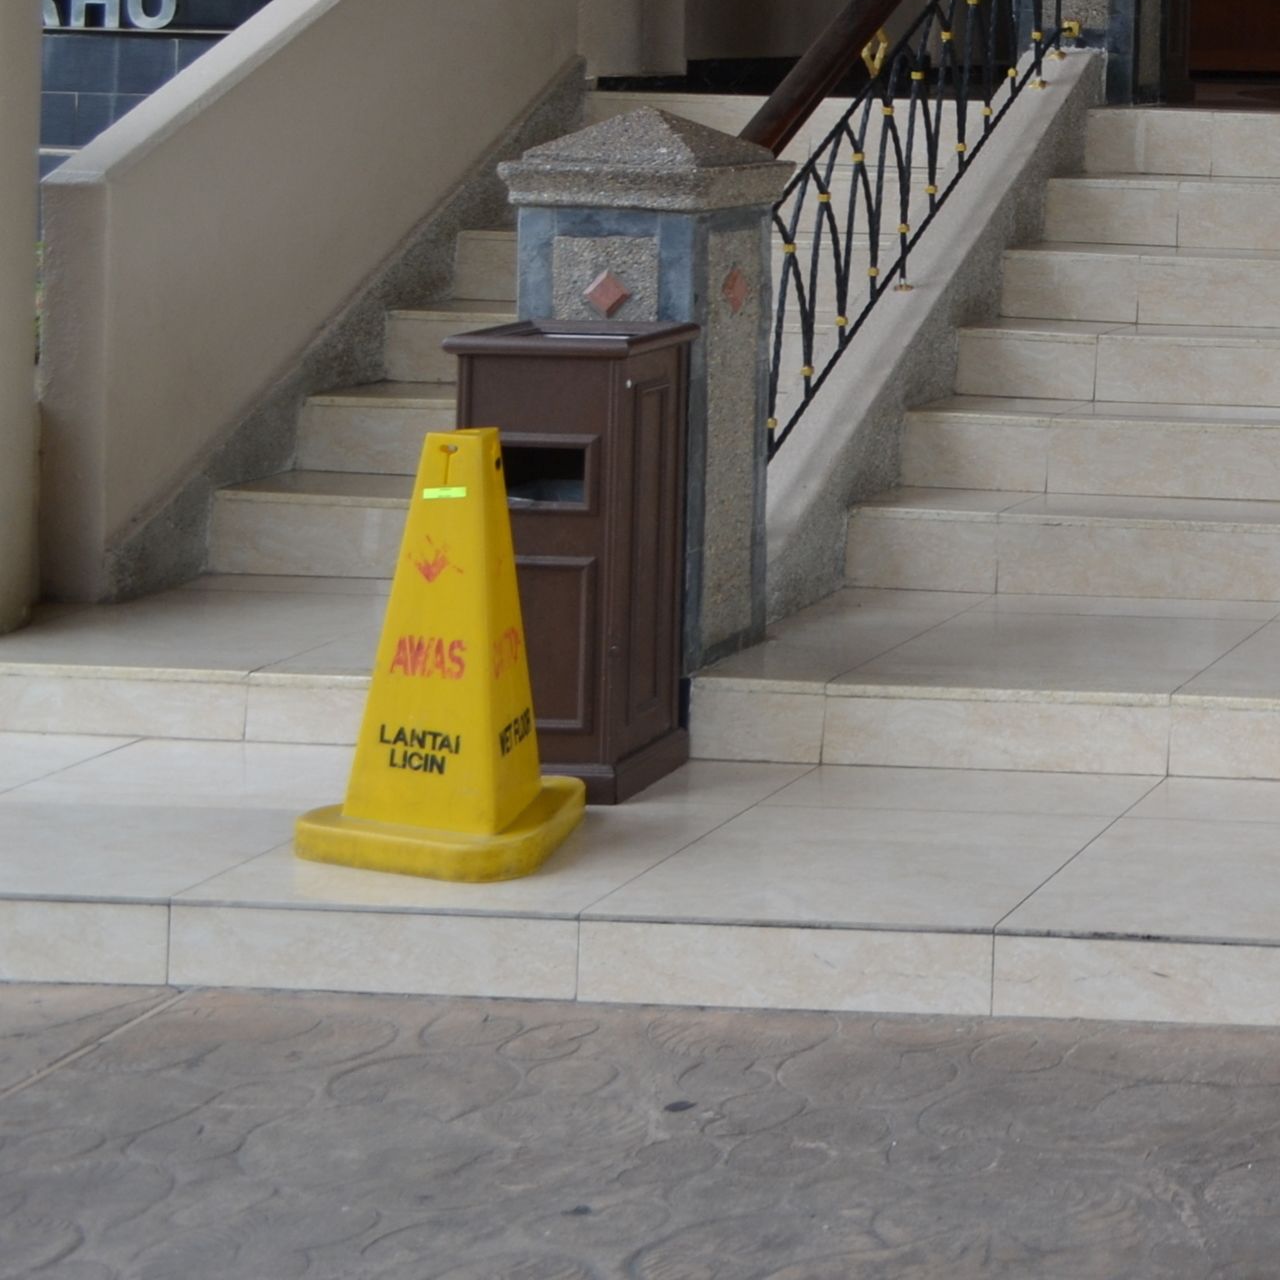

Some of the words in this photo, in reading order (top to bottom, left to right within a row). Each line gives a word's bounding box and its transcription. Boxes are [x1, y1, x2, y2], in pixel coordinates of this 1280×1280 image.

[390, 635, 467, 680] AWAS
[379, 724, 461, 755] LANTAI
[389, 748, 446, 775] LICIN
